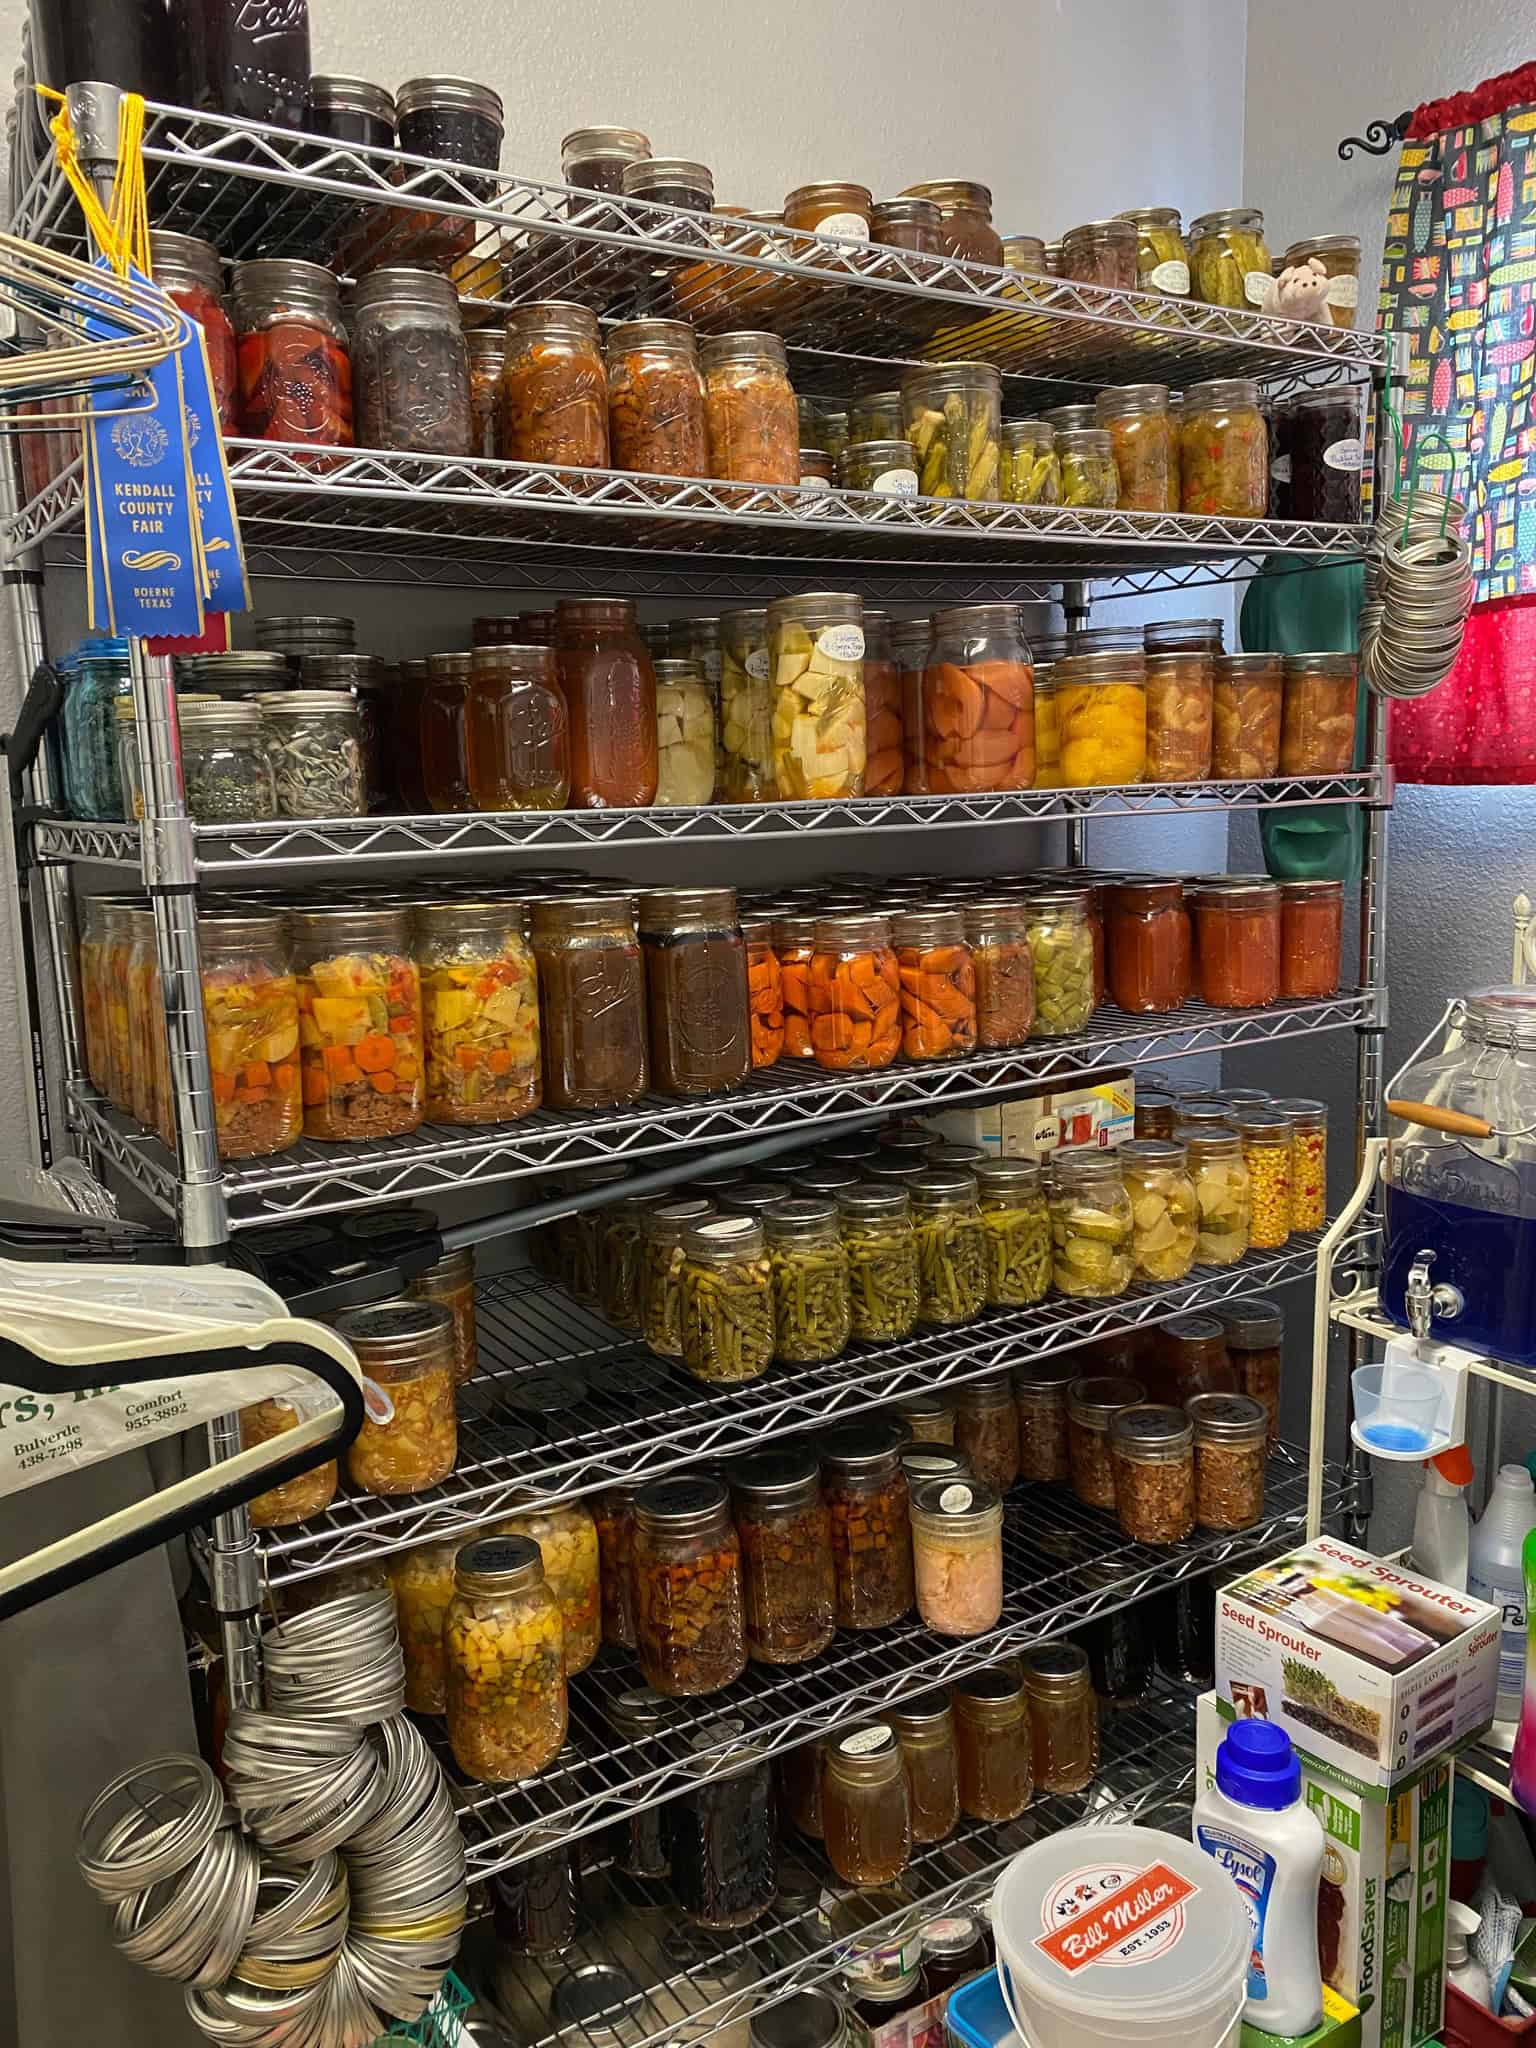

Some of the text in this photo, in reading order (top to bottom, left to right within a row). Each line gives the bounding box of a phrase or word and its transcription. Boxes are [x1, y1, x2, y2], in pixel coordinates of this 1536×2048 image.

[114, 482, 176, 498] KENDALL
[119, 501, 174, 516] COUNTY
[132, 519, 164, 534] FAIR
[134, 586, 176, 598] BOERNE
[139, 598, 173, 609] TEXAS
[124, 1402, 189, 1432] 955-3892
[125, 1389, 183, 1417] Comfort
[13, 1423, 81, 1457] Bulverde
[17, 1437, 83, 1471] 438-7298
[1314, 1542, 1478, 1617] Seed Sprouter
[1222, 1602, 1255, 1629] Seed
[1258, 1620, 1322, 1661] Sprouter
[1217, 1849, 1262, 1882] Lysol
[1061, 1882, 1175, 1959] Bill Miller
[1359, 1876, 1377, 1994] FoodSaver
